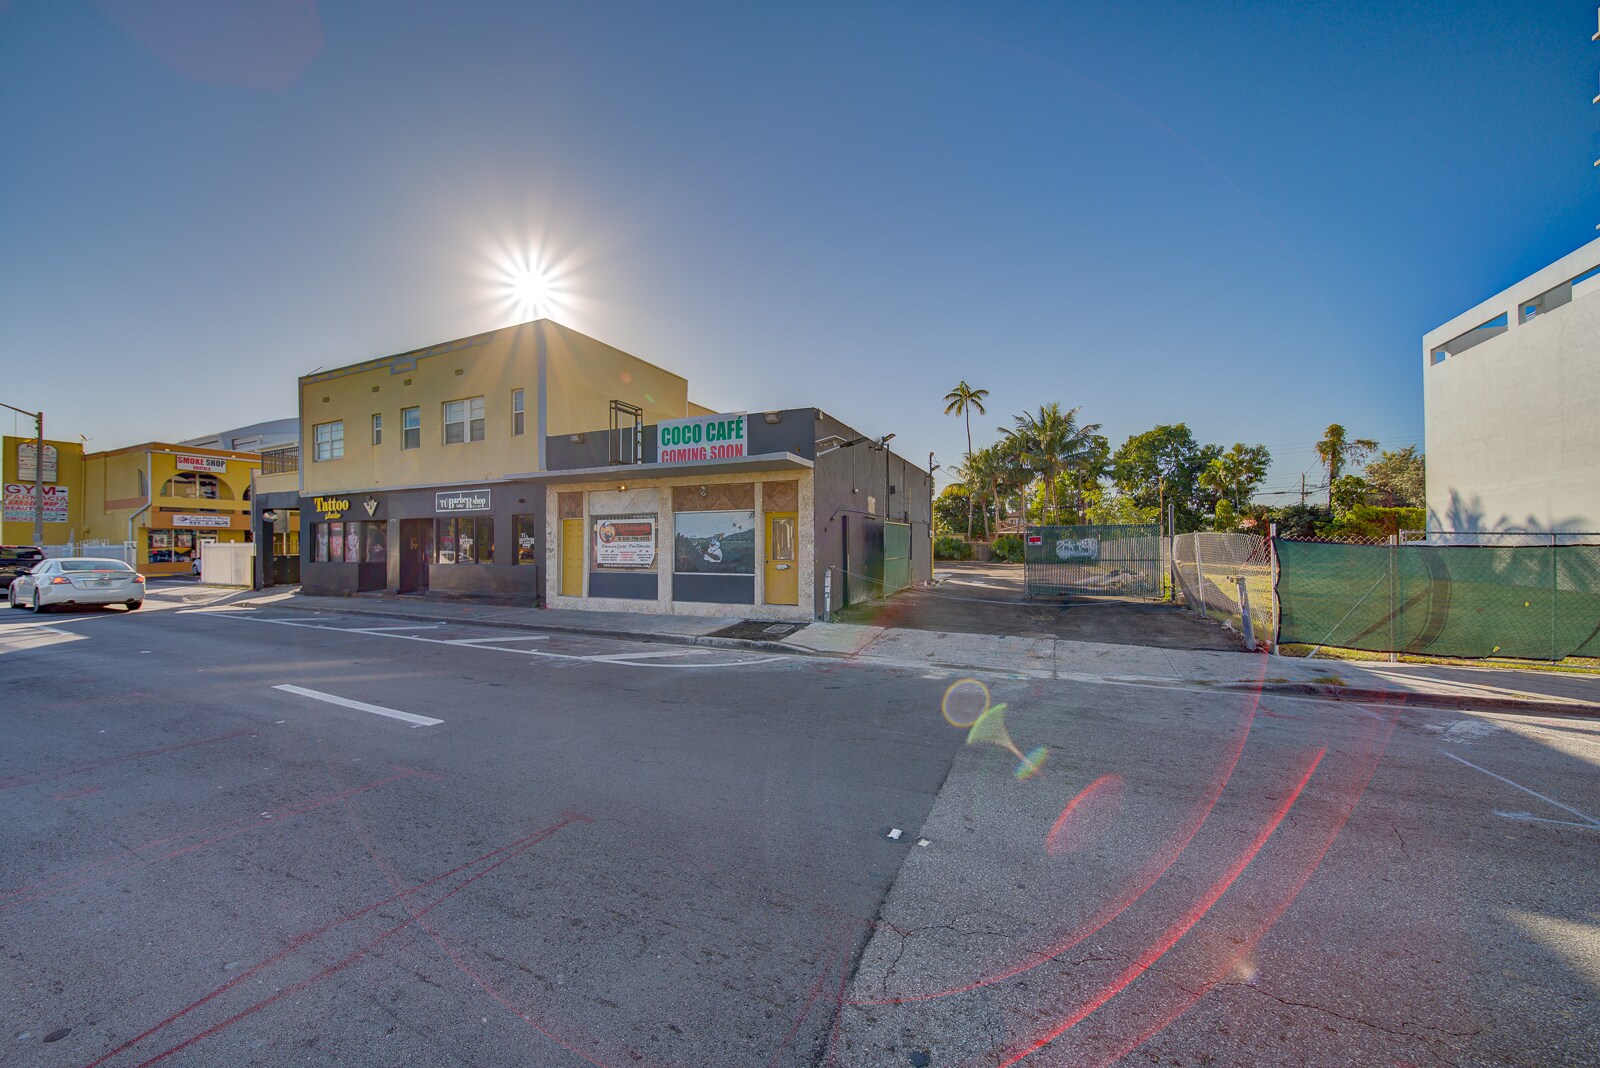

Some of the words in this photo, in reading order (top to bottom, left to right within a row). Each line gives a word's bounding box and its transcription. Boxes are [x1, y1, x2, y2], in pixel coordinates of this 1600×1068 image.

[661, 423, 703, 447] COCO
[706, 415, 744, 442] CAFÉ
[661, 446, 707, 463] COMING
[709, 443, 743, 460] SOON
[178, 457, 204, 466] SMOKE
[205, 459, 226, 468] SHOP
[5, 484, 56, 496] GYM
[314, 497, 350, 513] Tattoo
